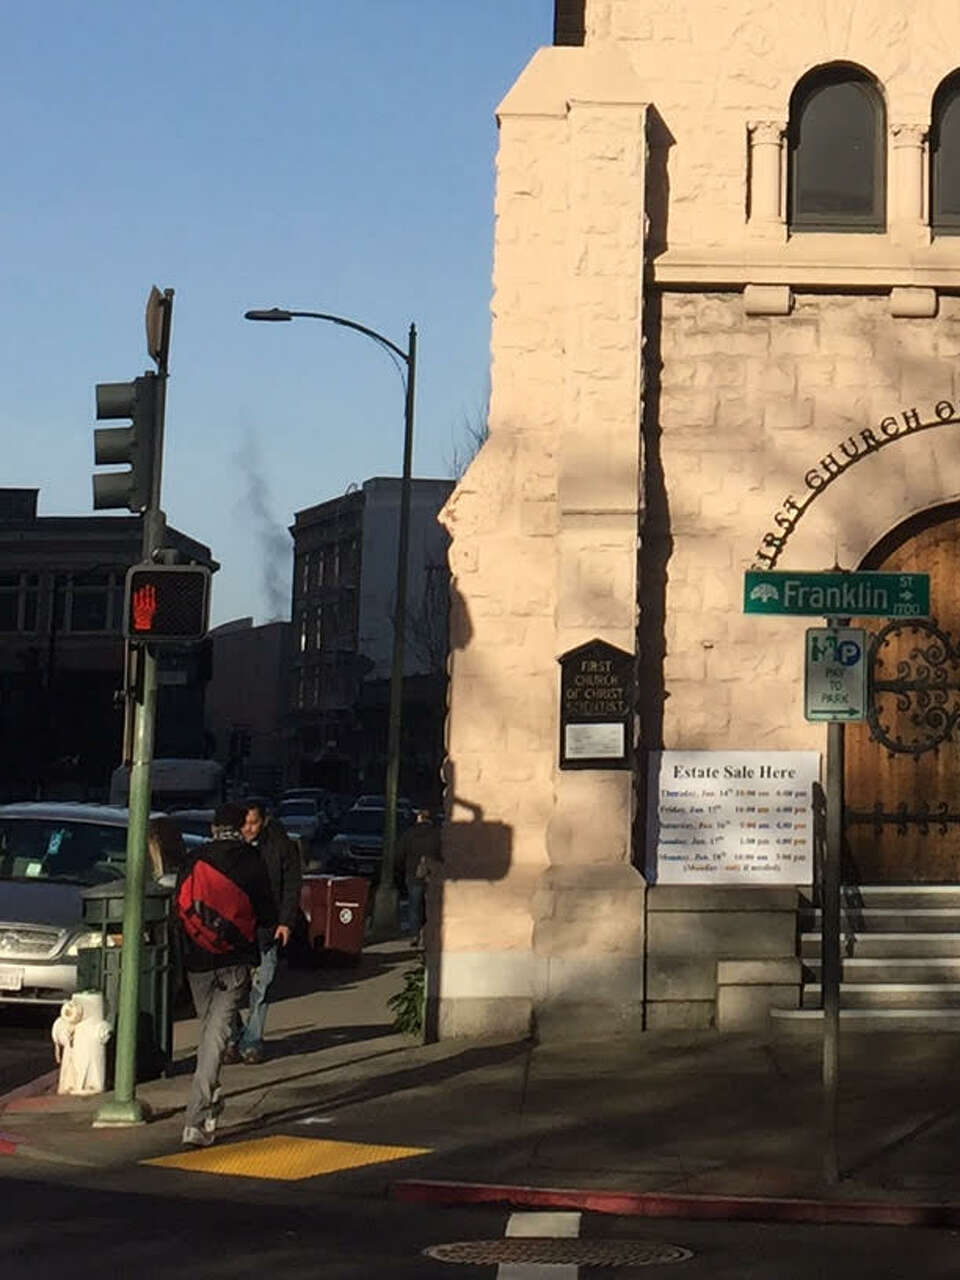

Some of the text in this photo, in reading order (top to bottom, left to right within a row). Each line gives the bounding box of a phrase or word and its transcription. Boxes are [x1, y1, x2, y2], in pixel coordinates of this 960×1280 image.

[804, 407, 923, 491] CHURCH
[783, 576, 913, 609] Franklin ST
[581, 660, 613, 672] FIRST
[829, 680, 842, 691] TO
[673, 765, 797, 779] Estate Sale Here
